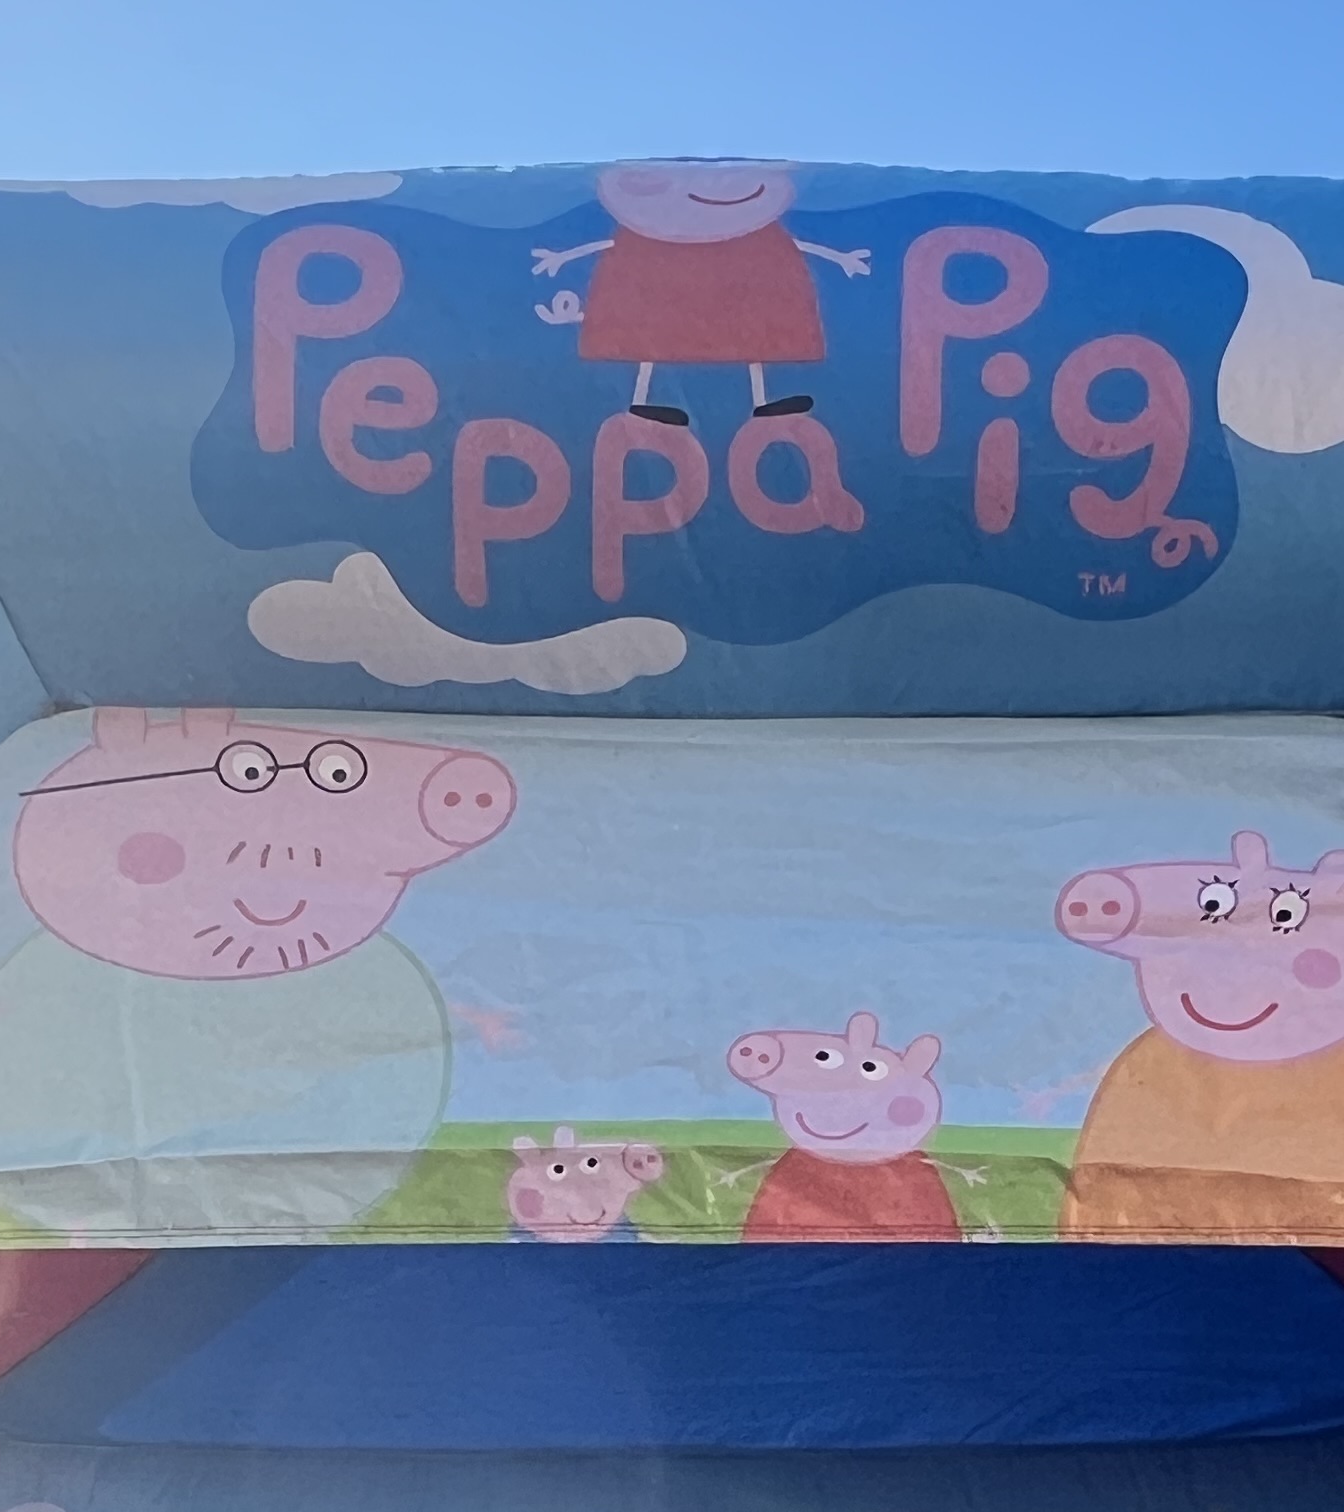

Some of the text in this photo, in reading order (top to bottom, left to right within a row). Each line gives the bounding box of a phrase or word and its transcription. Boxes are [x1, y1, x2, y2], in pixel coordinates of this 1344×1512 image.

[254, 225, 1218, 606] Peppa Pig
[1078, 571, 1127, 596] TM
